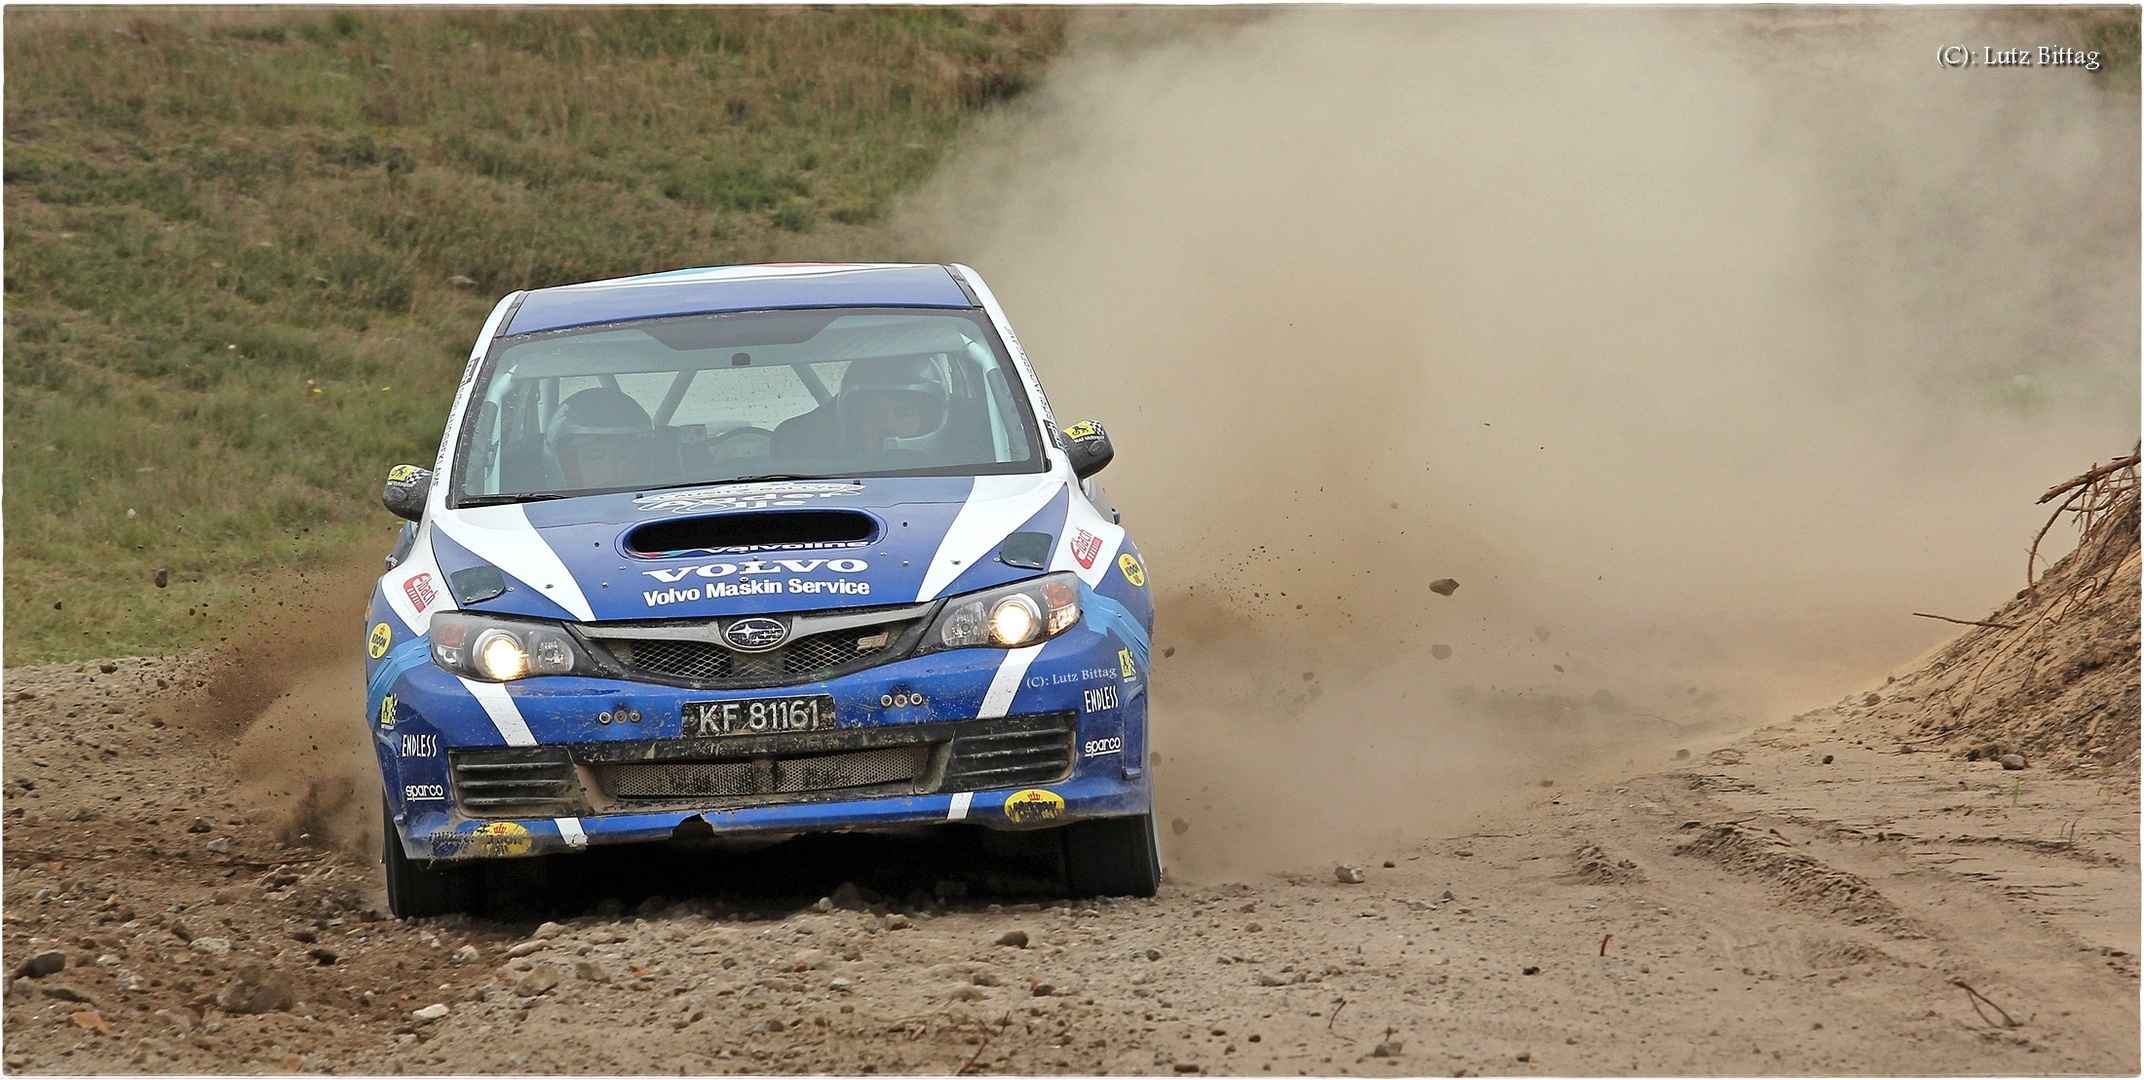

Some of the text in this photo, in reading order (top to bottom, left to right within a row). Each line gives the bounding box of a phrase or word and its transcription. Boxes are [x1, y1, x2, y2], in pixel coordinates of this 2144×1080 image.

[642, 559, 868, 583] VOLVO
[643, 578, 870, 607] Volvo Maskin Service
[1084, 685, 1119, 713] ENDLESS
[700, 700, 819, 735] KF 81161
[402, 734, 437, 758] ENDLESS
[1085, 737, 1121, 758] sparco
[405, 784, 445, 802] sparco
